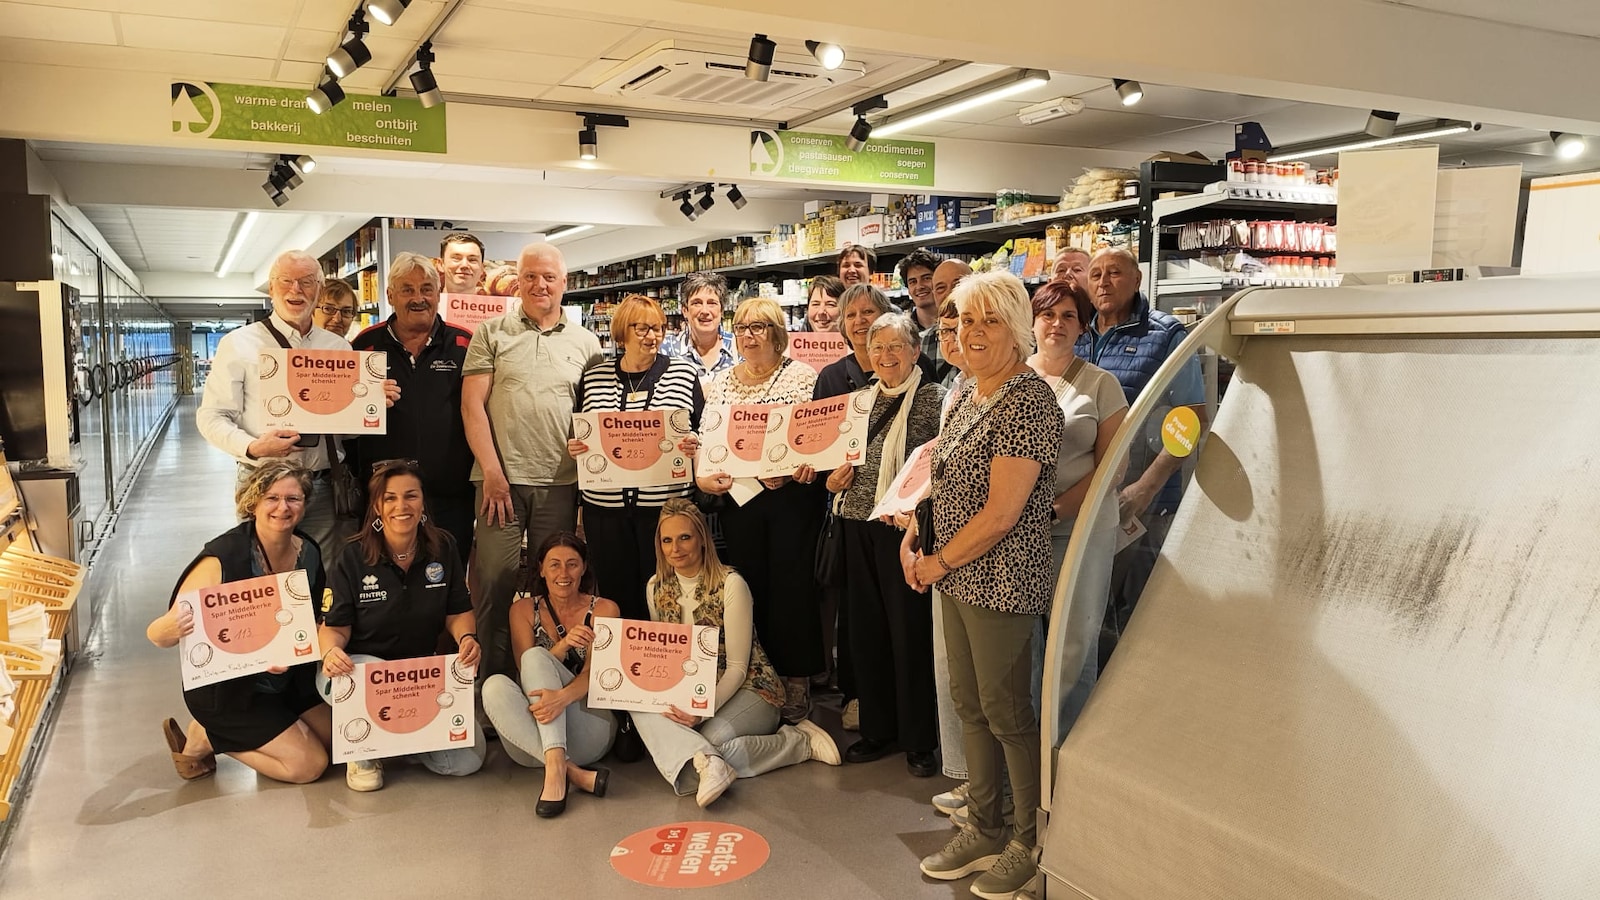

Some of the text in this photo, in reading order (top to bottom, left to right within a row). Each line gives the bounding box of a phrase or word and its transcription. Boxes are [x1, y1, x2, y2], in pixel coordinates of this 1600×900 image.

[234, 94, 277, 106] warme
[352, 100, 392, 113] melen
[251, 120, 302, 135] bakkerij
[375, 118, 418, 132] ontbijt
[346, 132, 412, 146] beschuiten
[790, 136, 833, 147] conserven
[866, 143, 925, 156] condimenten
[799, 151, 853, 163] pastasausen
[896, 159, 926, 169] soepen
[788, 164, 840, 176] deegwaren
[879, 170, 920, 180] conserven
[450, 299, 504, 313] Cheque
[793, 338, 844, 352] Cheque
[292, 356, 356, 372] Cheque
[298, 388, 310, 402] €
[733, 410, 768, 424] Cheq
[794, 402, 845, 420] Cheque
[603, 418, 661, 431] Cheque
[734, 438, 744, 450] €
[794, 434, 804, 446] €
[612, 446, 645, 460] € 285
[204, 586, 275, 608] Cheque
[359, 590, 388, 600] FINTRO
[211, 602, 272, 619] Spar Middelkerke
[228, 612, 257, 622] schenkt
[217, 628, 231, 644] €
[626, 626, 688, 646] Cheque
[644, 646, 683, 654] Middelkerke
[370, 667, 441, 685] Cheque
[630, 662, 642, 676] €
[393, 684, 436, 693] Middelkerke
[392, 692, 420, 700] schenkt
[378, 706, 391, 722] €
[678, 832, 712, 875] weken
[708, 832, 744, 877] Gratis-
